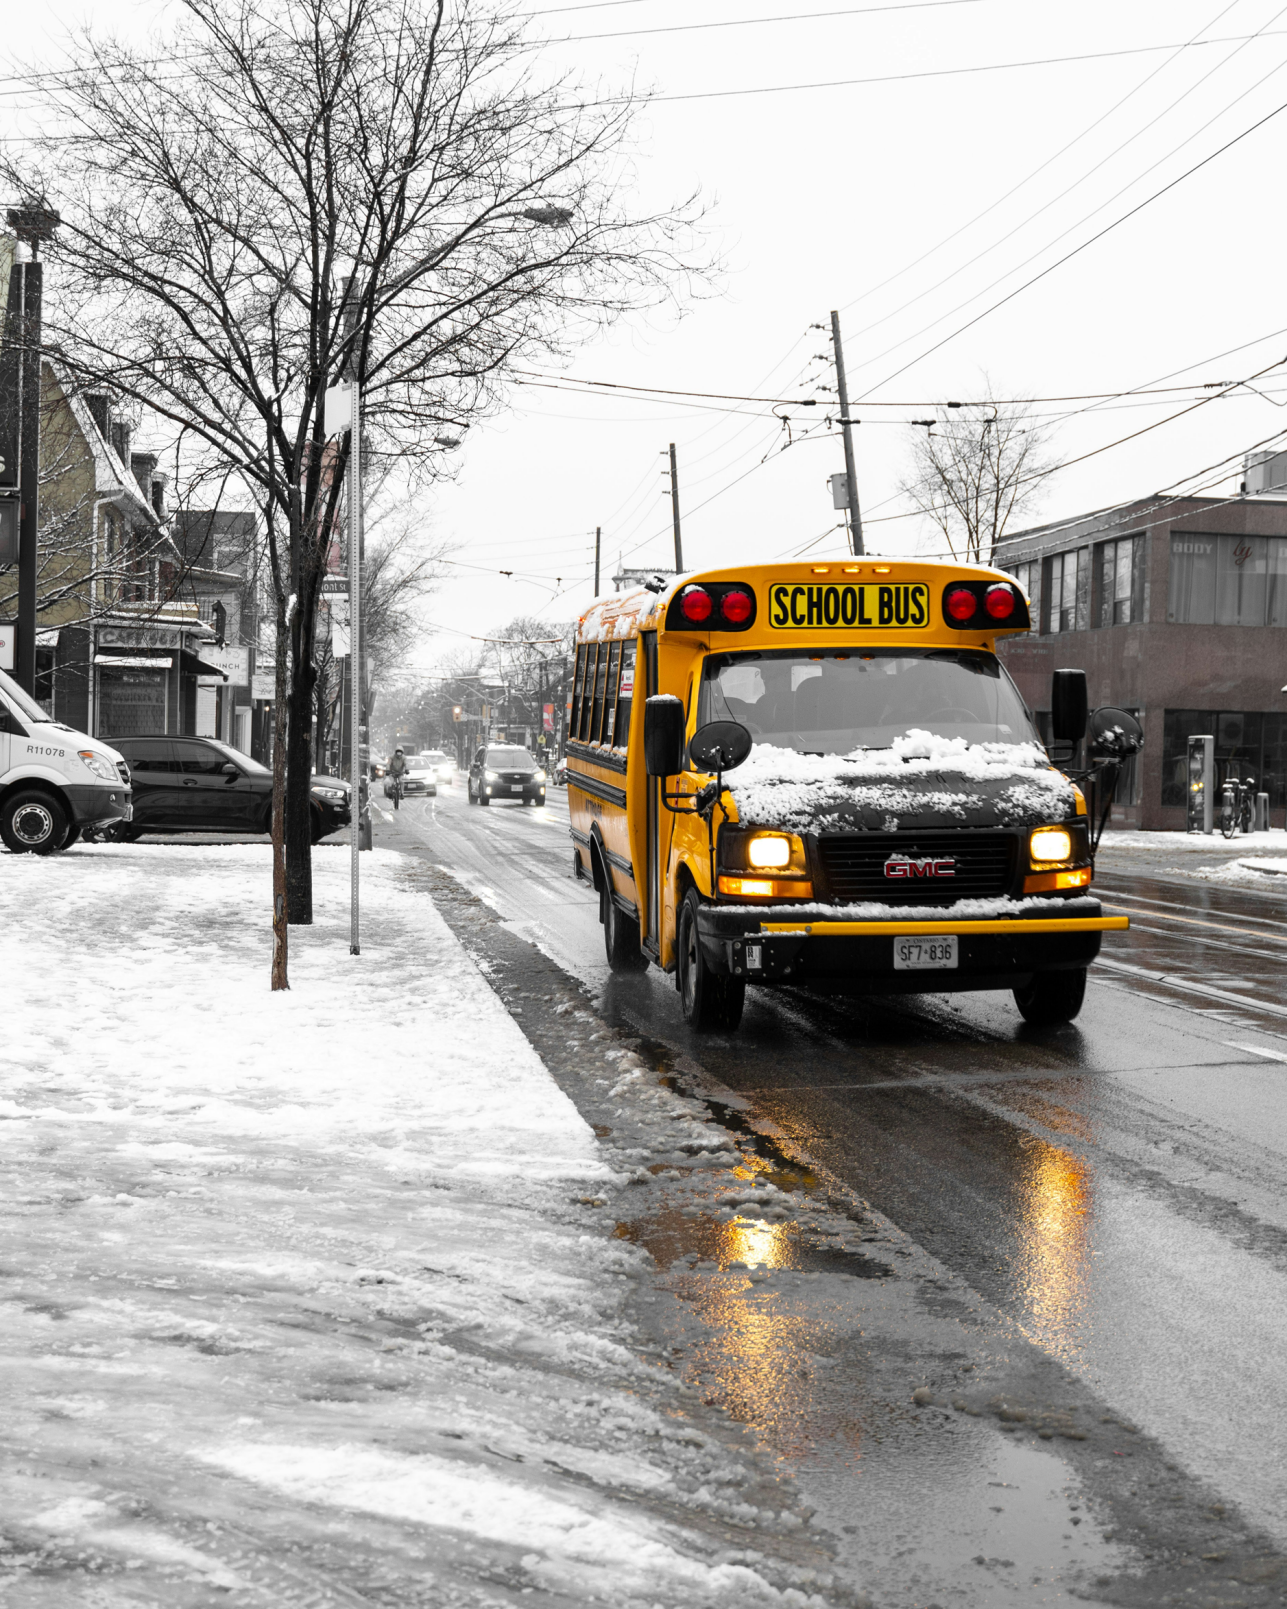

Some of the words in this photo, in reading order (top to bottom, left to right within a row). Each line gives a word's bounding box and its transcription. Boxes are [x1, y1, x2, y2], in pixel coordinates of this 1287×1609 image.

[1173, 543, 1212, 554] BODY
[774, 586, 872, 625] SCHOOL
[879, 586, 925, 625] BUS
[26, 745, 65, 757] R11078
[884, 859, 956, 878] GMC
